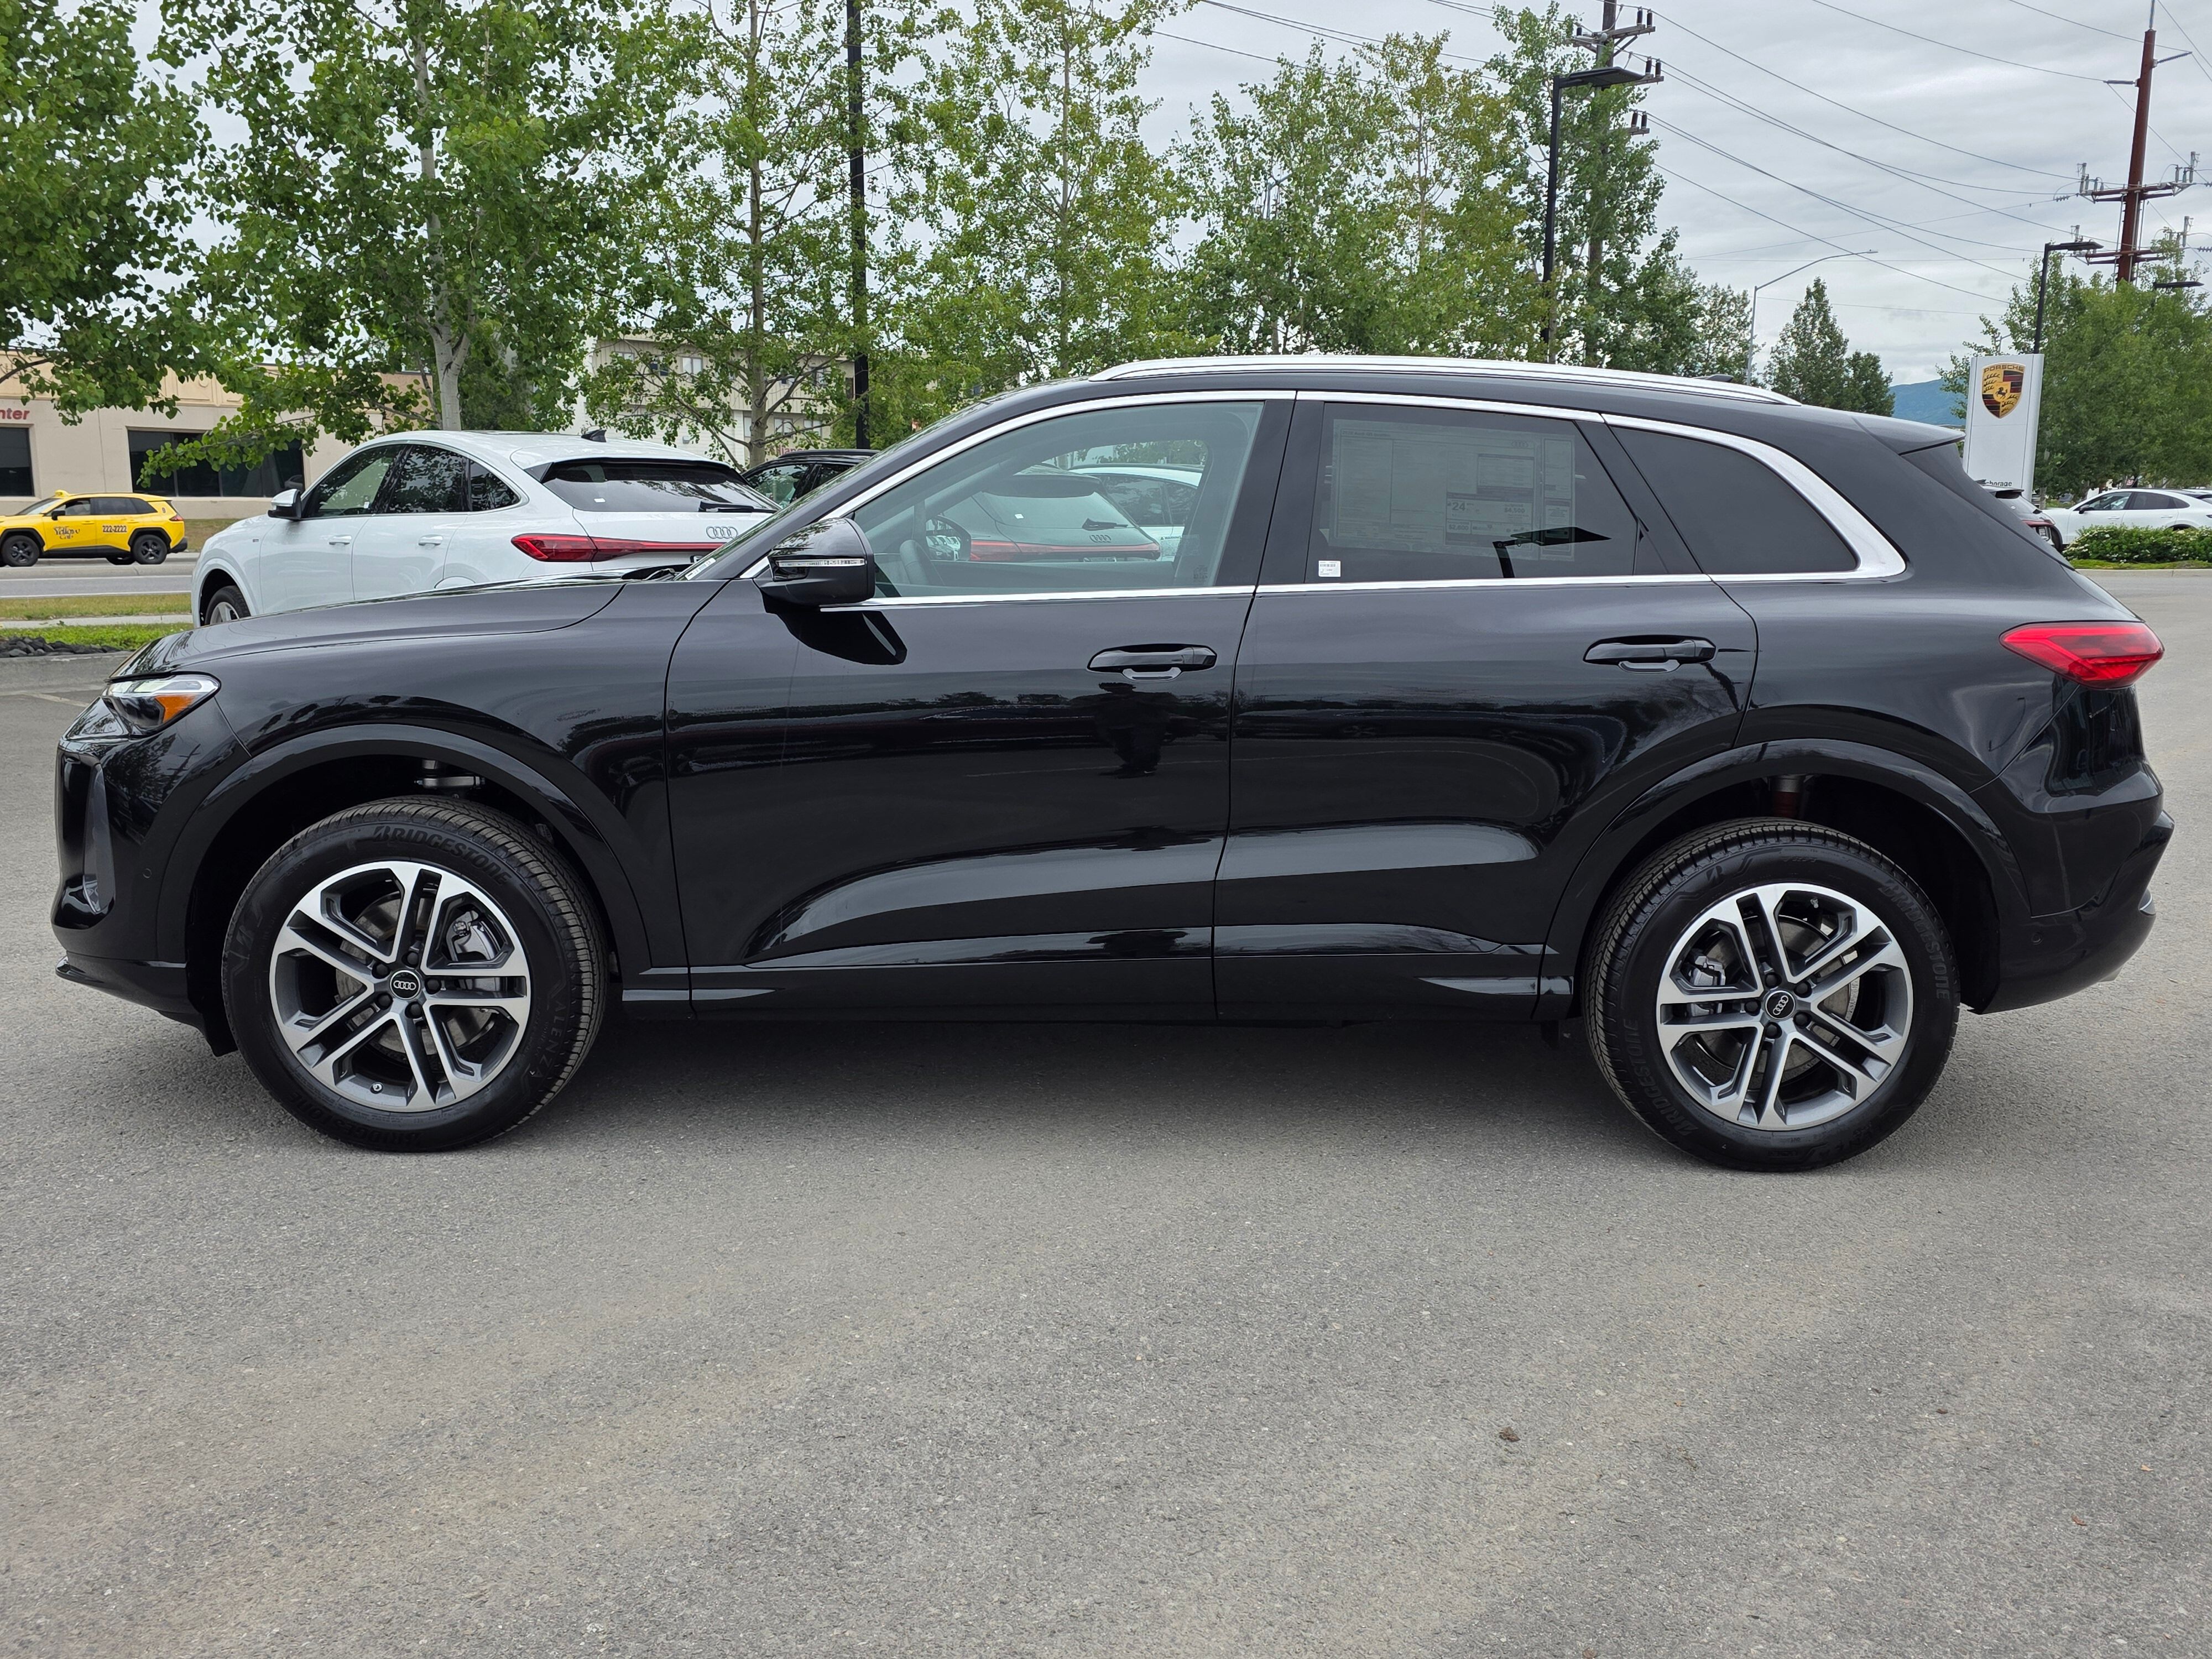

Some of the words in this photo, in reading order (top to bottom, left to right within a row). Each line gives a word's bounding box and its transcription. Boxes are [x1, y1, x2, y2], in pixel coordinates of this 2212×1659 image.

[1984, 364, 2025, 373] PORSCHE
[1452, 502, 1466, 511] 24
[374, 826, 513, 885] BRIDGESTONE
[1877, 879, 1950, 999] BRIDGESTONE
[531, 1000, 567, 1078] ALENZA
[1623, 1019, 1699, 1136] BRIDGESTONE
